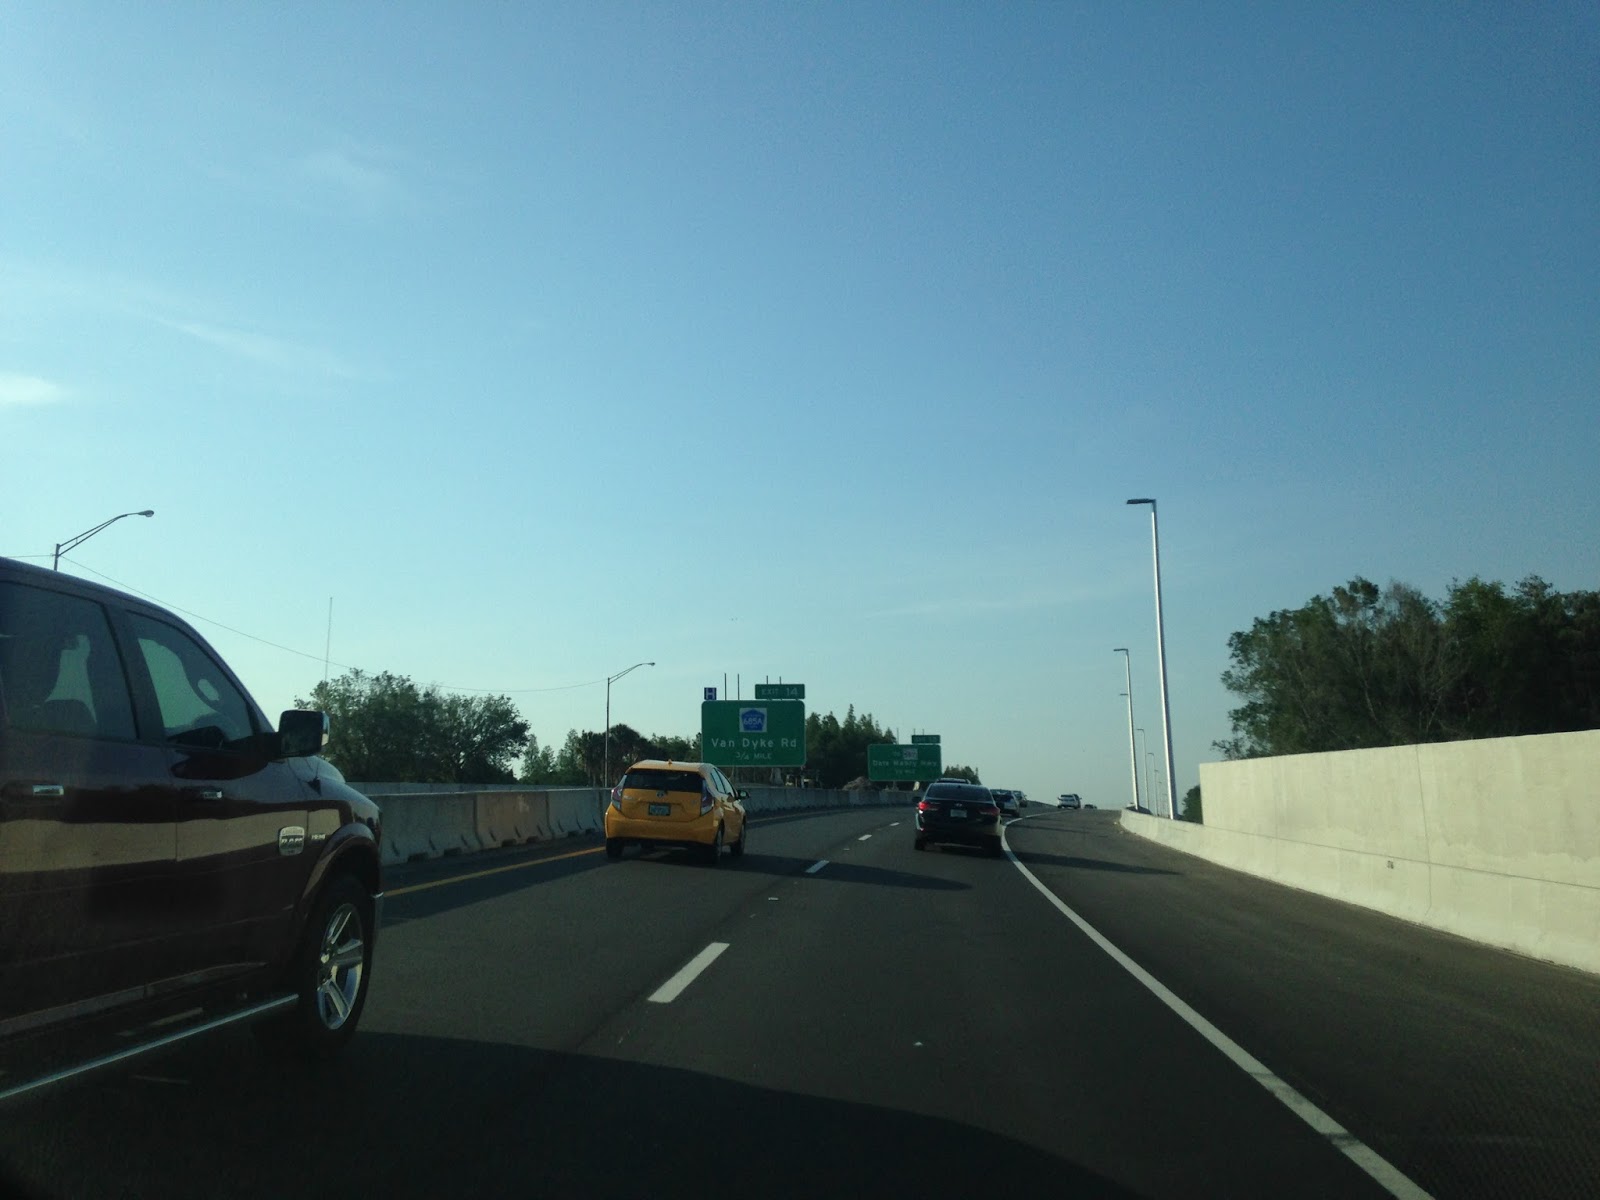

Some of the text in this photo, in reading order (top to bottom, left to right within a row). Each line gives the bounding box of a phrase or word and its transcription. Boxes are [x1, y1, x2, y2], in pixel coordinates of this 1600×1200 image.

[761, 687, 798, 697] EXIT 14
[743, 717, 763, 726] 685A
[711, 738, 797, 750] Van Dyke Rd
[754, 752, 773, 760] MILE
